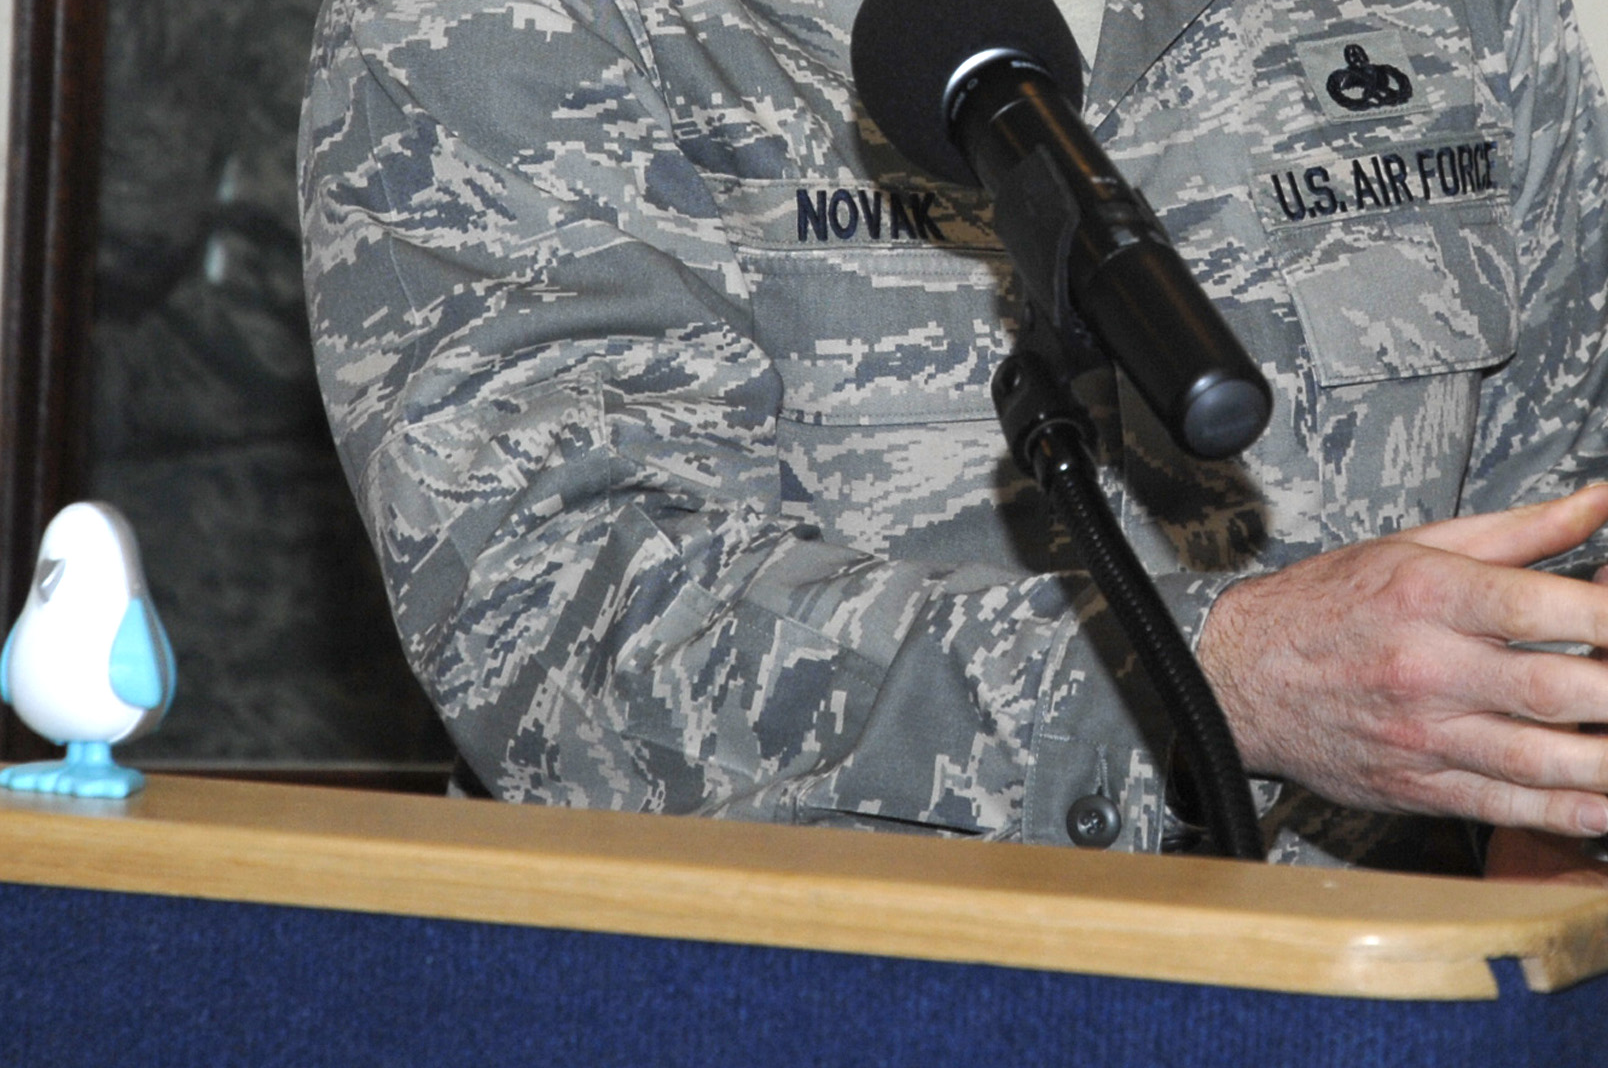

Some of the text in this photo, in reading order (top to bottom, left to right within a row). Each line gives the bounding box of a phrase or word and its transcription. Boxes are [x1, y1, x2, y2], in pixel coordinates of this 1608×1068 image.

[1271, 140, 1498, 221] U.S. AIR FORCE
[796, 188, 946, 242] NOVAK
